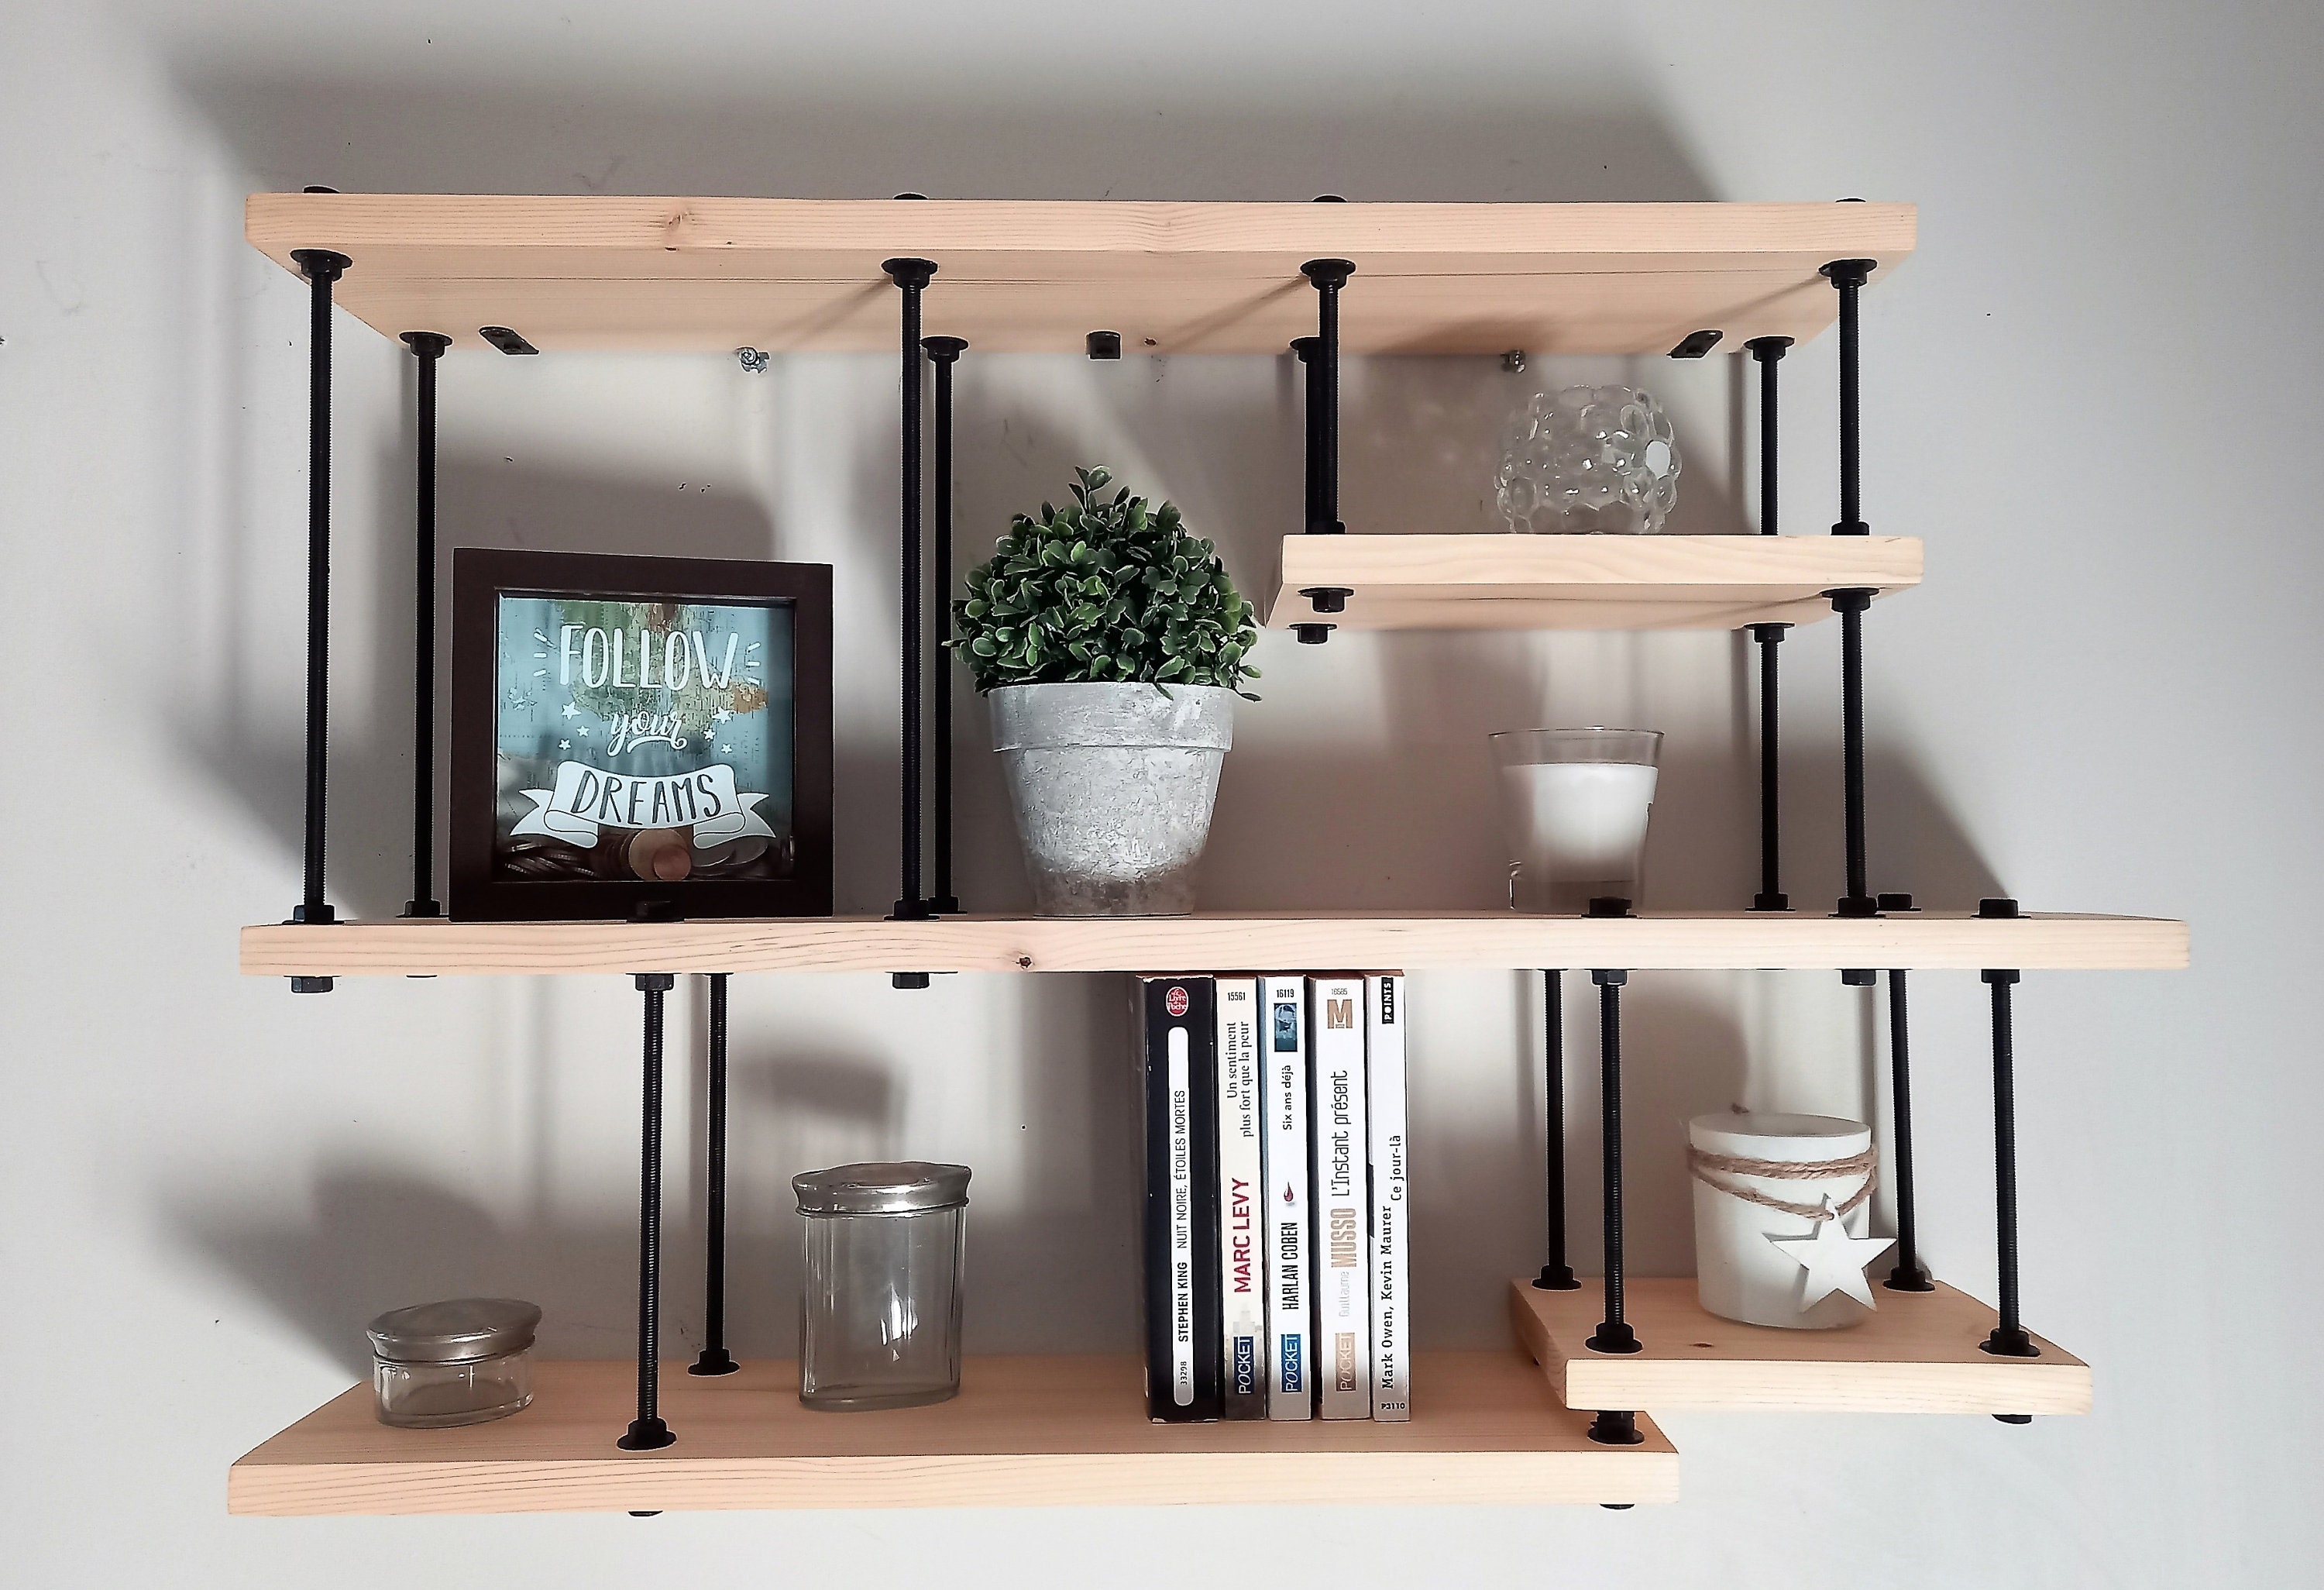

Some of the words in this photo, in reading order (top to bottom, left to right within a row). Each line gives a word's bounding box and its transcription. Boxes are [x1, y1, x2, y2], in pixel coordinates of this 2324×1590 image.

[558, 624, 739, 691] FOLLOW
[607, 710, 688, 758] your
[570, 769, 722, 826] DREAMS
[1227, 991, 1246, 1001] 15561
[1276, 988, 1294, 998] 16119
[1383, 981, 1393, 1021] POINTS
[1239, 1020, 1253, 1048] peur
[1327, 999, 1353, 1029] M
[1225, 1021, 1237, 1079] sentiment
[1238, 1051, 1250, 1062] la
[1226, 1082, 1238, 1099] Un
[1239, 1065, 1253, 1087] que
[1281, 1065, 1294, 1089] déjà
[1174, 1089, 1186, 1134] MORTES
[1239, 1089, 1251, 1111] fort
[1284, 1091, 1293, 1110] ans
[1329, 1069, 1352, 1125] présent
[1239, 1113, 1254, 1137] plus
[1281, 1112, 1293, 1131] Six
[1172, 1137, 1187, 1180] ÉTOILES
[1390, 1135, 1404, 1182] jour-là
[1174, 1183, 1188, 1221] NOIRE,
[1231, 1177, 1250, 1230] LEVY
[1391, 1186, 1401, 1201] Ce
[1176, 1223, 1188, 1249] NUIT
[1280, 1222, 1298, 1261] COBEN
[1330, 1208, 1357, 1268] MUSSO
[1379, 1205, 1392, 1255] Maurer
[1177, 1261, 1188, 1289] KING
[1232, 1234, 1251, 1293] MARC
[1380, 1260, 1393, 1300] Kevin
[1281, 1265, 1299, 1310] HARLAN
[1177, 1292, 1189, 1342] STEPHEN
[1380, 1306, 1394, 1348] Owen,
[1239, 1336, 1251, 1395] POCKET
[1284, 1334, 1298, 1392] POCKET
[1339, 1333, 1353, 1391] POCKET
[1380, 1353, 1394, 1390] Mark
[1380, 1402, 1406, 1410] P3110
